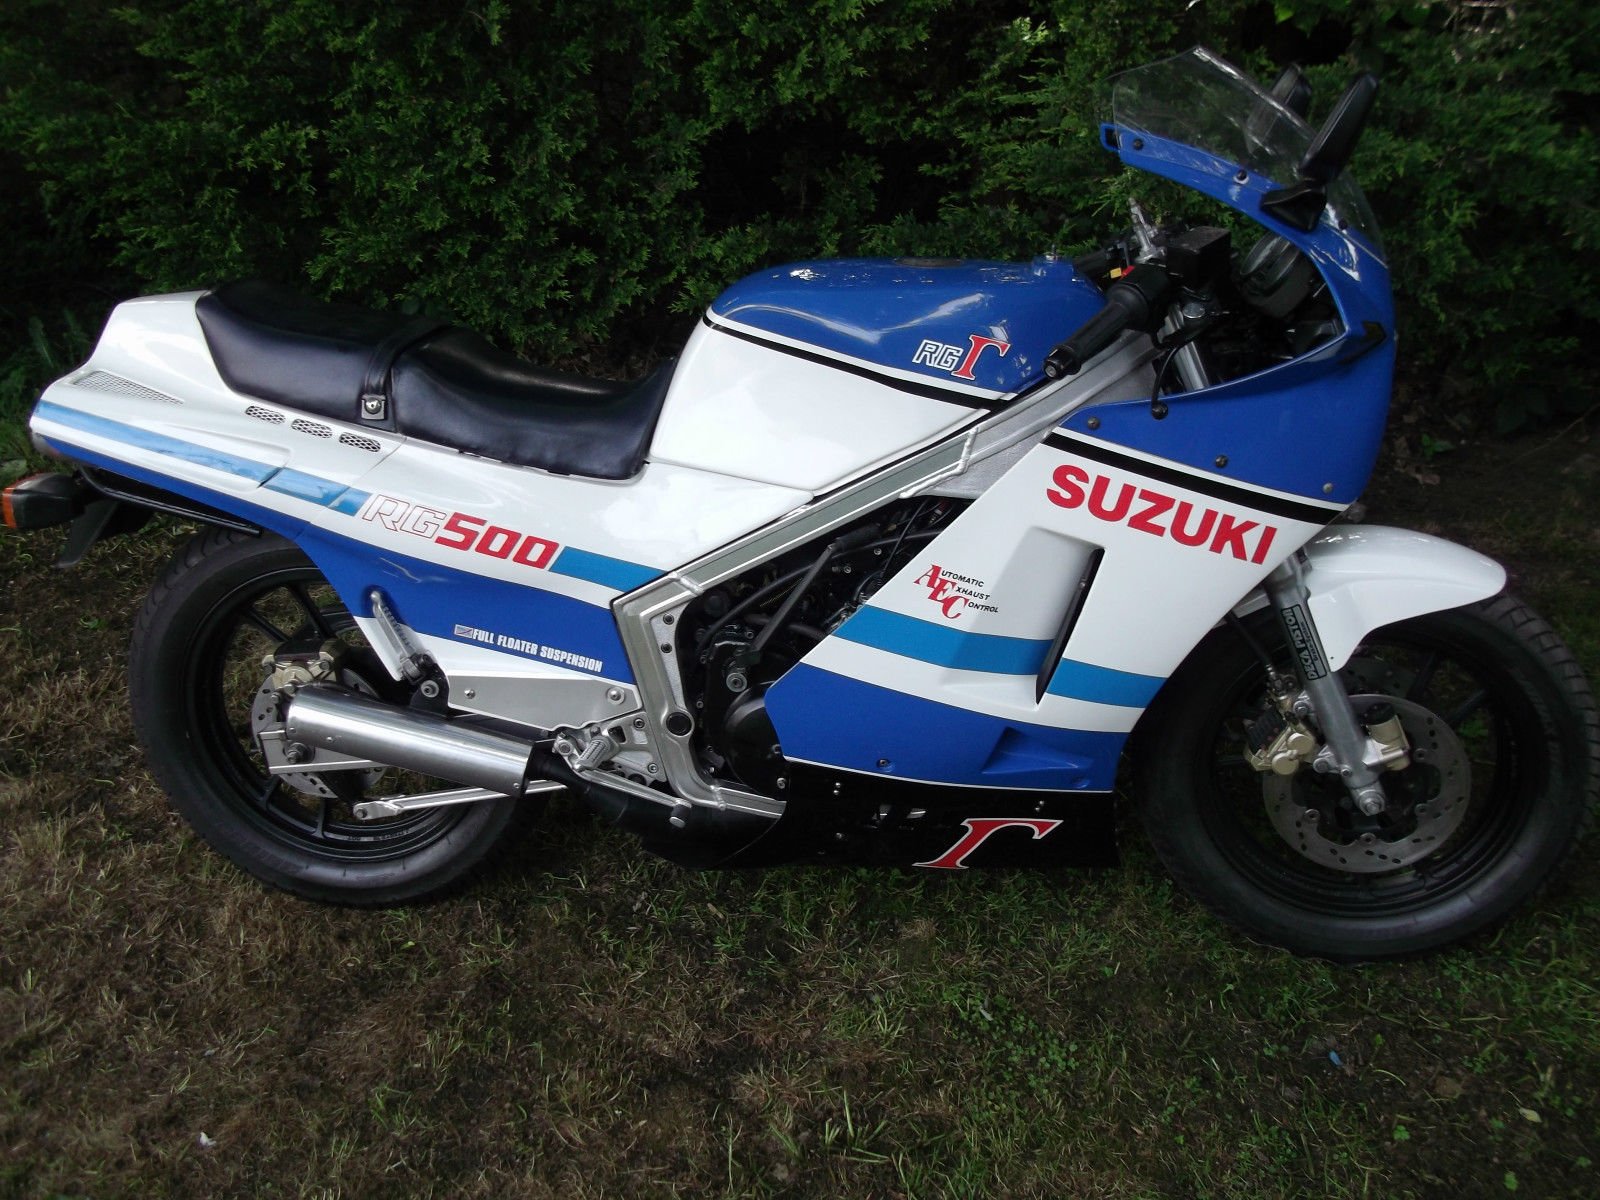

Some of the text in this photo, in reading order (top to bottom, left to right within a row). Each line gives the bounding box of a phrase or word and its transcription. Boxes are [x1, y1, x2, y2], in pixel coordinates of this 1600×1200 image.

[362, 494, 560, 569] RG500
[1046, 464, 1278, 565] SUZUKI
[913, 564, 984, 589] AUTOMATIC
[928, 577, 990, 603] EXHAUST
[942, 595, 999, 619] CONTROL
[472, 629, 603, 673] FULL FLOATER SUSPENSION
